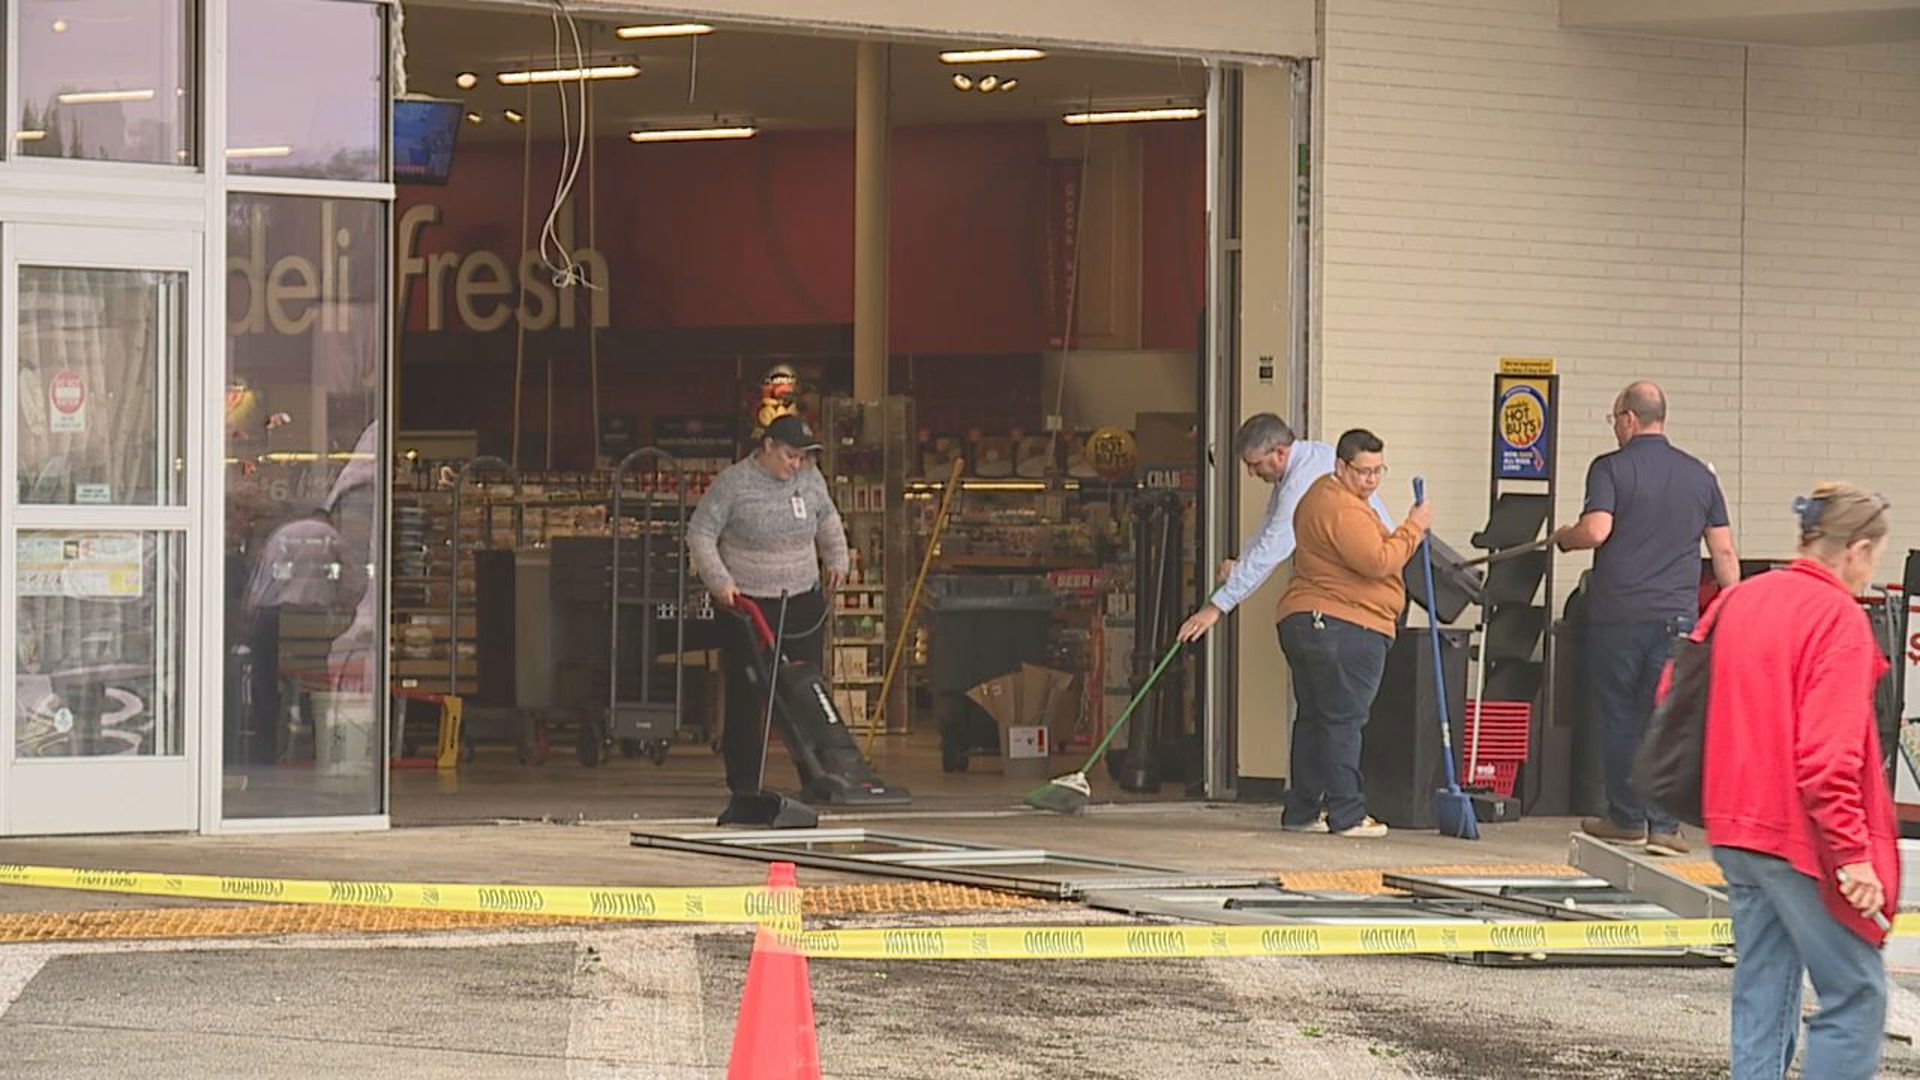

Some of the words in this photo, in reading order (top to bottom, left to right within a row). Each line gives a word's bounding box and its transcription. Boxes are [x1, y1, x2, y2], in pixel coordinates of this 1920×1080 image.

[226, 201, 352, 336] deli
[399, 197, 611, 333] fresh
[1504, 407, 1530, 423] HOT
[1505, 419, 1537, 435] BUYS
[1095, 438, 1122, 452] HOT
